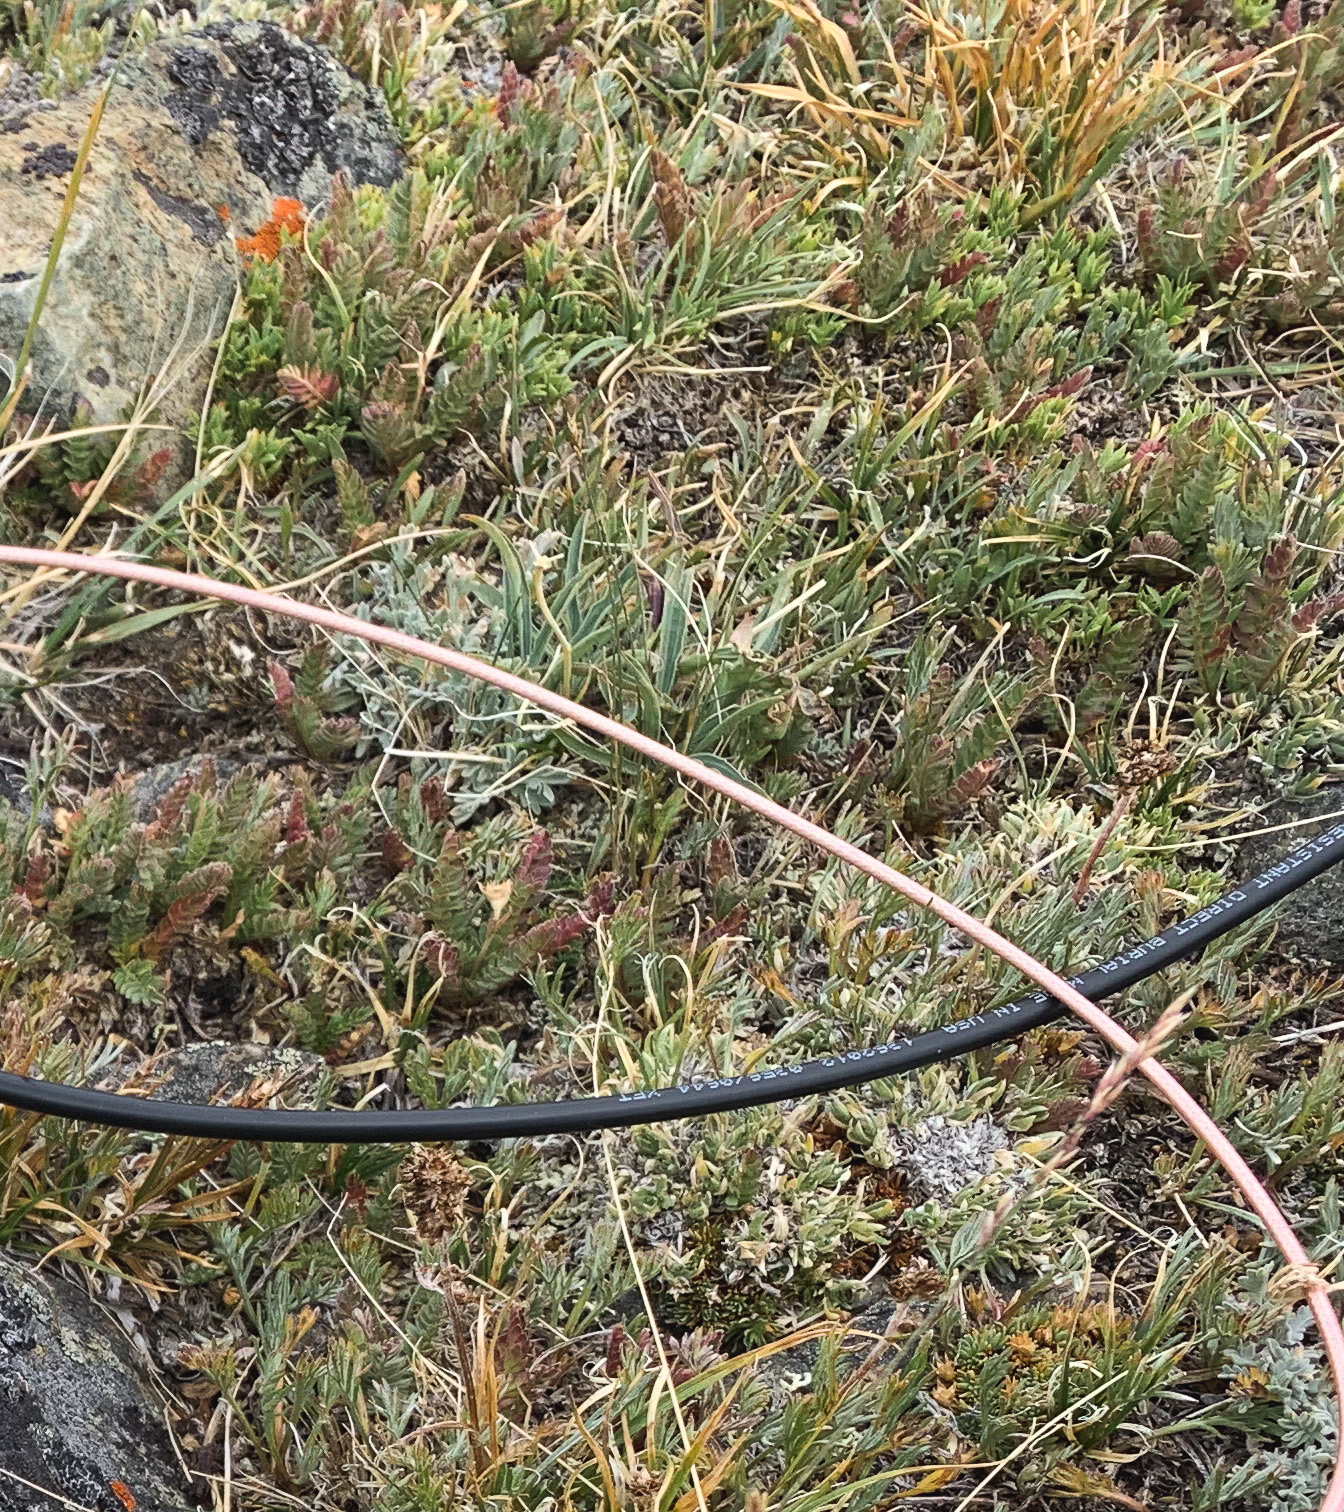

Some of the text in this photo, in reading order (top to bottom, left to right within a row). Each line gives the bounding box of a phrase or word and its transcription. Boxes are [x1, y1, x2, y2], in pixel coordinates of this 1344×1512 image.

[1254, 823, 1344, 888] ESISTANT
[1175, 891, 1247, 936] DIRECT
[1091, 935, 1168, 977] BURIAL
[990, 1002, 1022, 1022] IN
